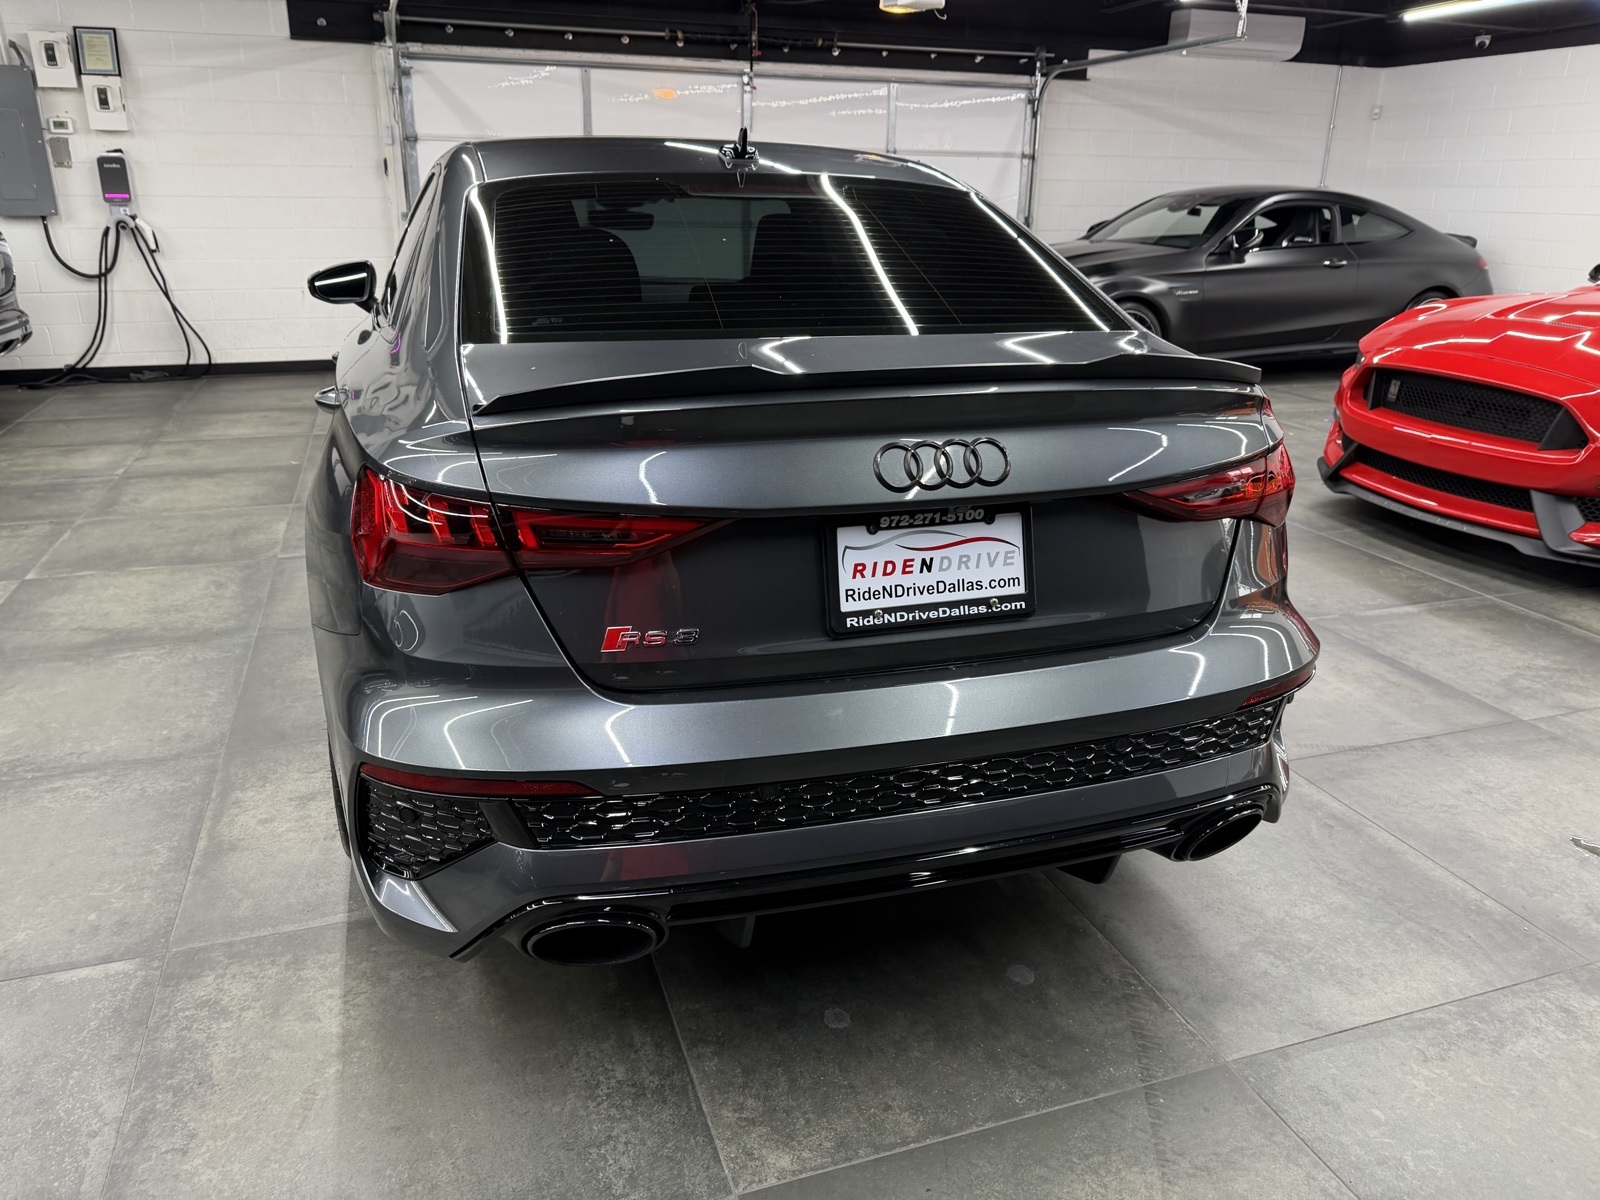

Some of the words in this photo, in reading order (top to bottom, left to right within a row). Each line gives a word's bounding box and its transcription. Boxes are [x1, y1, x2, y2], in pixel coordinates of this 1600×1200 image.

[879, 508, 985, 528] 972-271-5100
[844, 576, 1021, 603] RideNDriveDallas.com
[846, 601, 1026, 628] RideNDriveDallas.com
